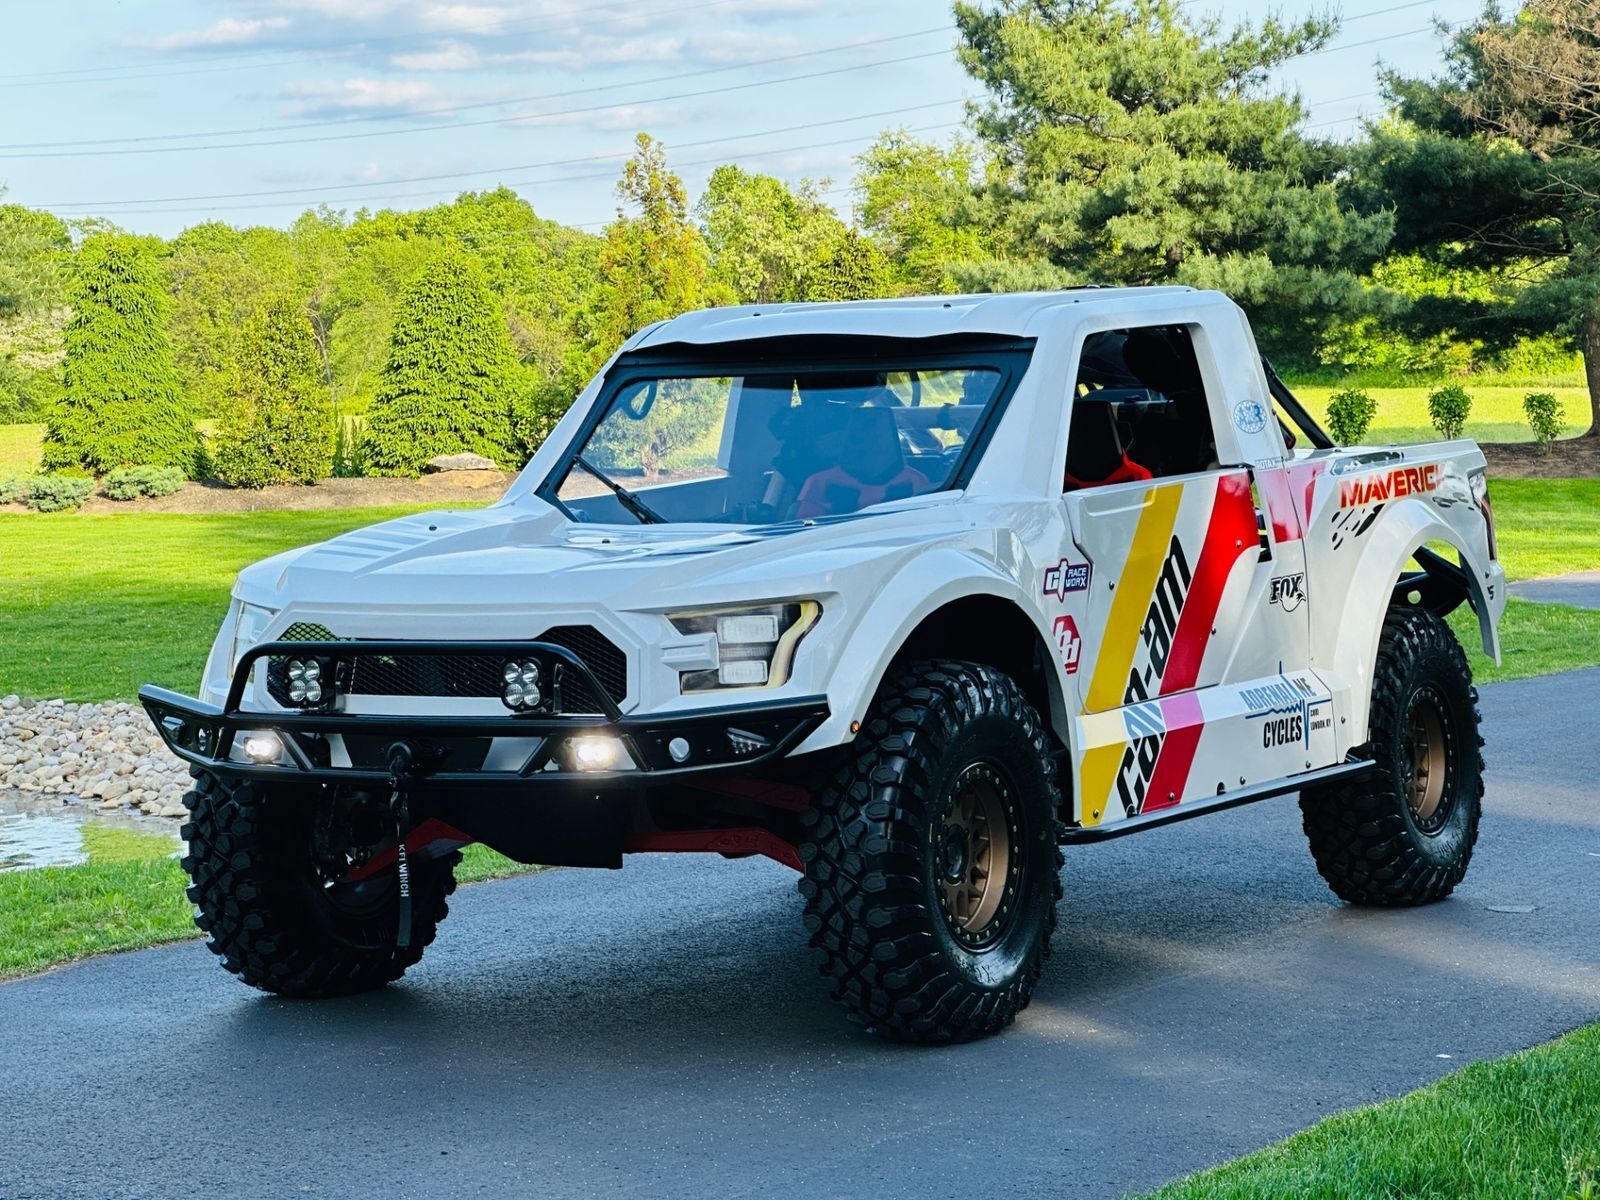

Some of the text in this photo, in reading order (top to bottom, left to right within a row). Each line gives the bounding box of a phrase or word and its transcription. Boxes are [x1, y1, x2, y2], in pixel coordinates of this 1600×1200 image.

[1066, 577, 1087, 588] WORX
[1068, 567, 1087, 578] RACE
[1271, 575, 1302, 601] FOX
[1263, 715, 1302, 748] CYCLES
[398, 863, 410, 897] WINCH
